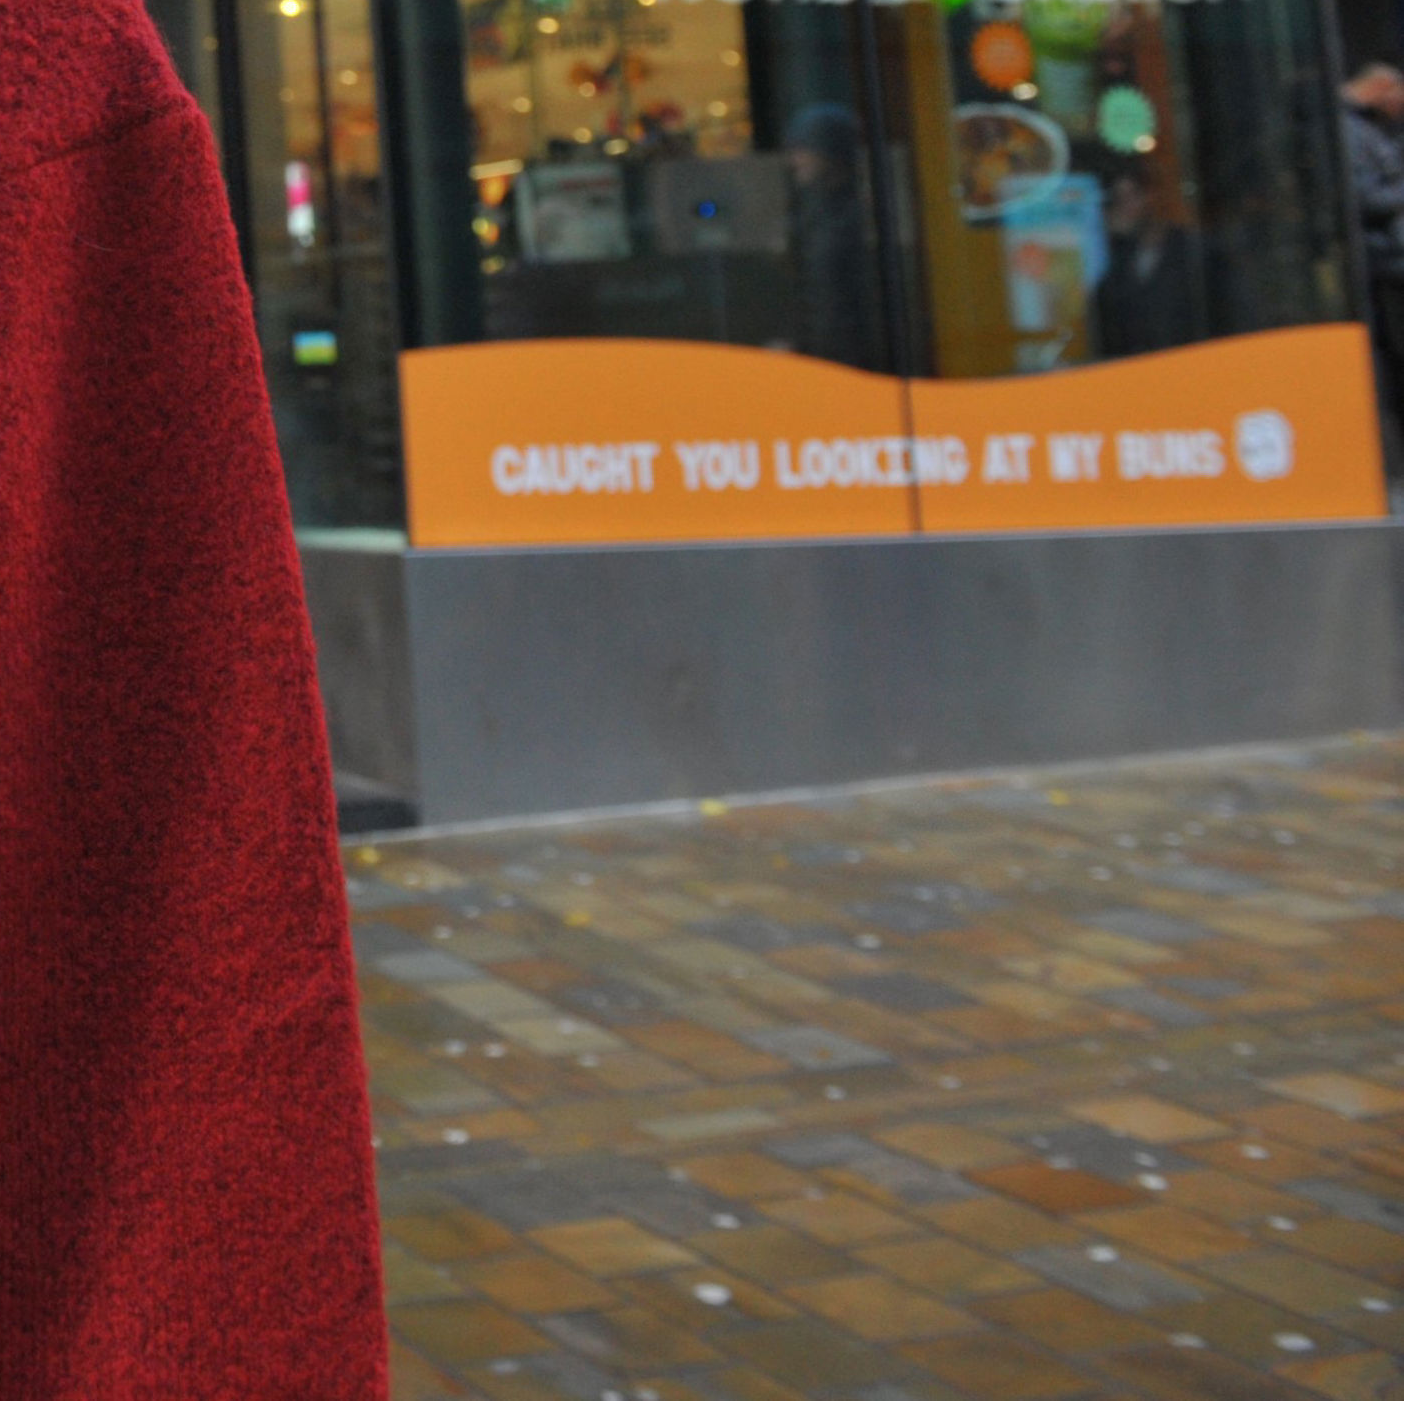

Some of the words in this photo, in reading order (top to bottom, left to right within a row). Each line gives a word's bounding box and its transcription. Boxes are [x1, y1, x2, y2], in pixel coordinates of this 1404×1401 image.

[492, 441, 660, 495] CAUGHT
[673, 439, 760, 491] YOU
[774, 435, 969, 489] LOOKING
[982, 433, 1035, 484] AT
[1046, 431, 1104, 483] MY
[1116, 429, 1226, 481] BUNS
